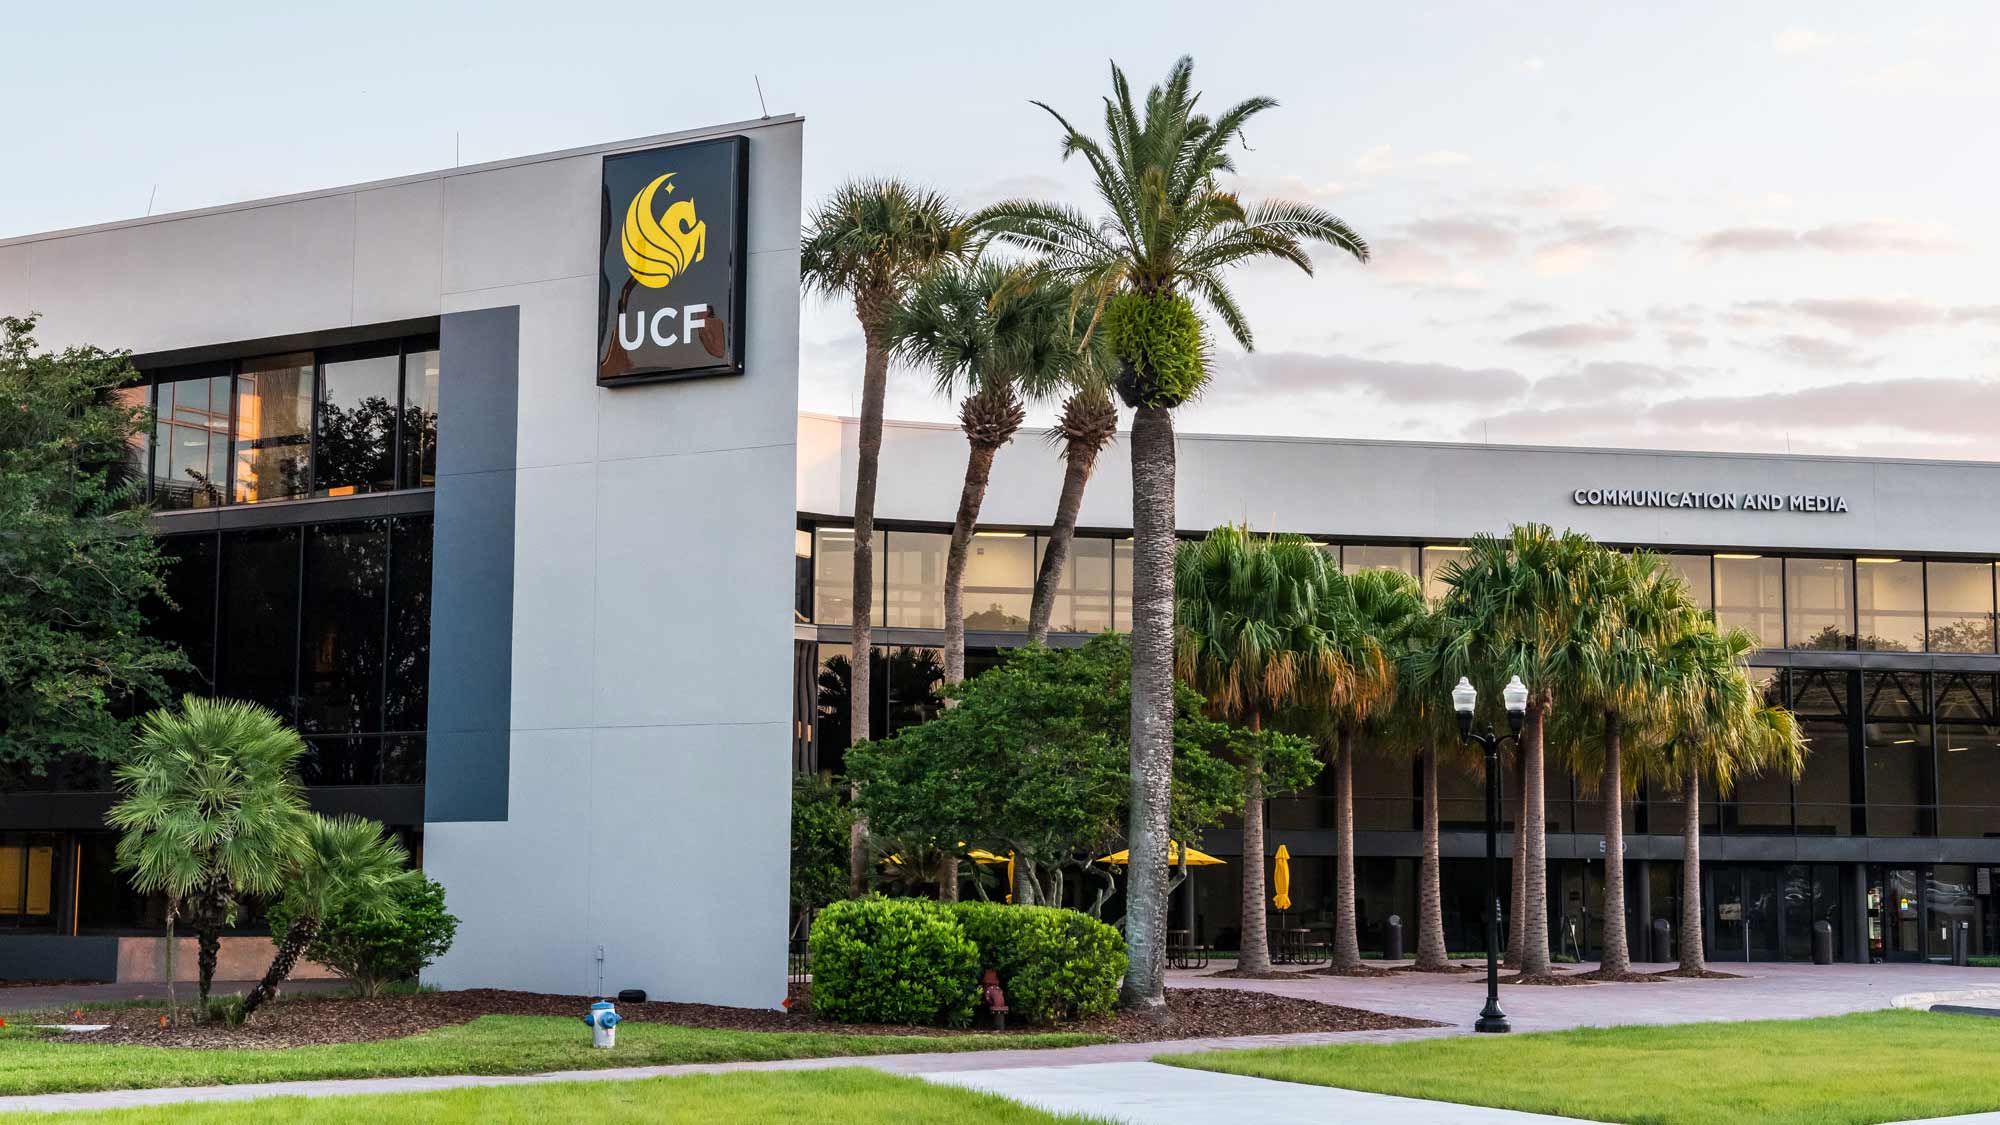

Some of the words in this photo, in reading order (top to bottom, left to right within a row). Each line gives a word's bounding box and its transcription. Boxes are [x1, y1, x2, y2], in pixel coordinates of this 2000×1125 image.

[618, 303, 708, 351] UCF
[1573, 488, 1737, 509] COMMUNICATION
[1742, 493, 1783, 511] AND
[1788, 495, 1849, 513] MEDIA
